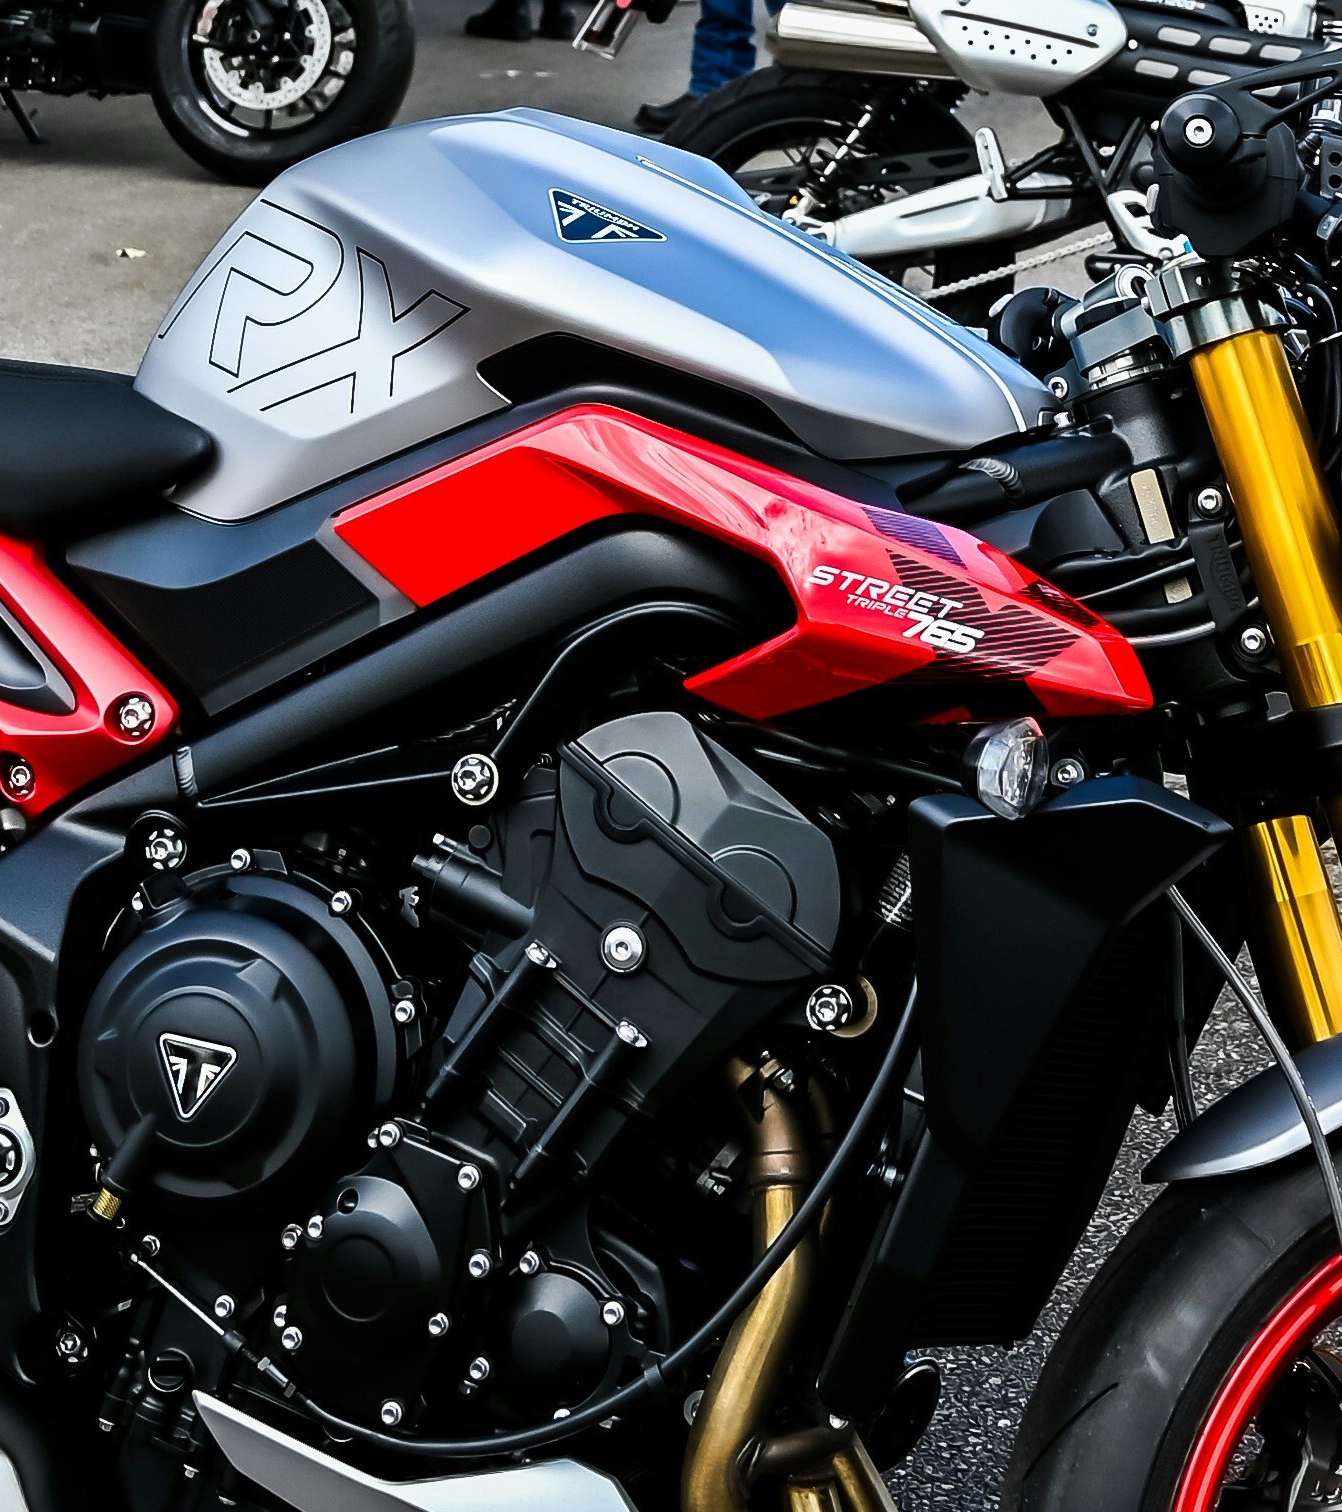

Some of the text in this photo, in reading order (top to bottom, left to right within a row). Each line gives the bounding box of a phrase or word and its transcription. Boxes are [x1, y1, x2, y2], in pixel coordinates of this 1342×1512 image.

[571, 197, 641, 232] TRIUMPH
[158, 198, 472, 414] RX
[808, 564, 964, 619] STREET
[1208, 532, 1243, 613] TRIUMPH
[846, 593, 985, 654] TRIPLE 765
